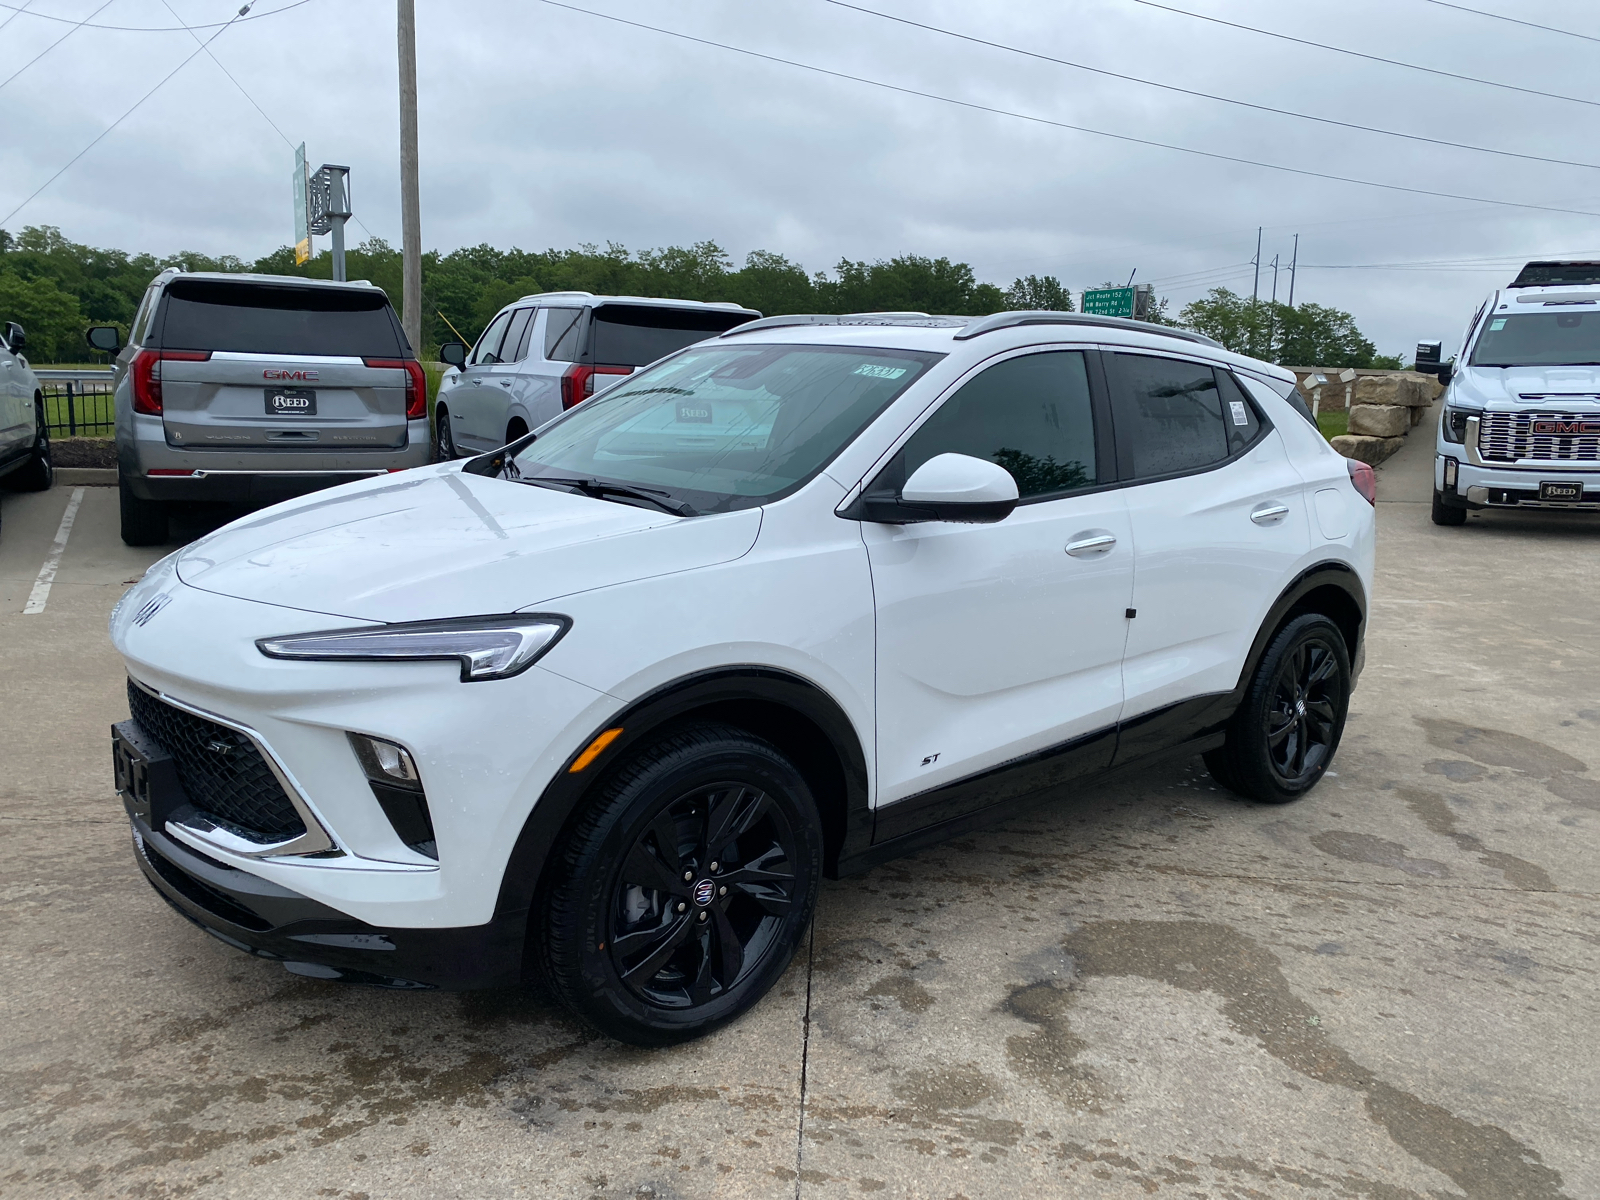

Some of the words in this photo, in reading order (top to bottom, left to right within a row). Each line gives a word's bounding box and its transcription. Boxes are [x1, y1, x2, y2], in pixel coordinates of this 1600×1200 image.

[263, 369, 319, 381] GMC
[272, 395, 309, 409] REED
[681, 408, 708, 418] REED
[1536, 422, 1600, 432] GMC
[1546, 486, 1576, 496] REED
[920, 752, 941, 767] ST
